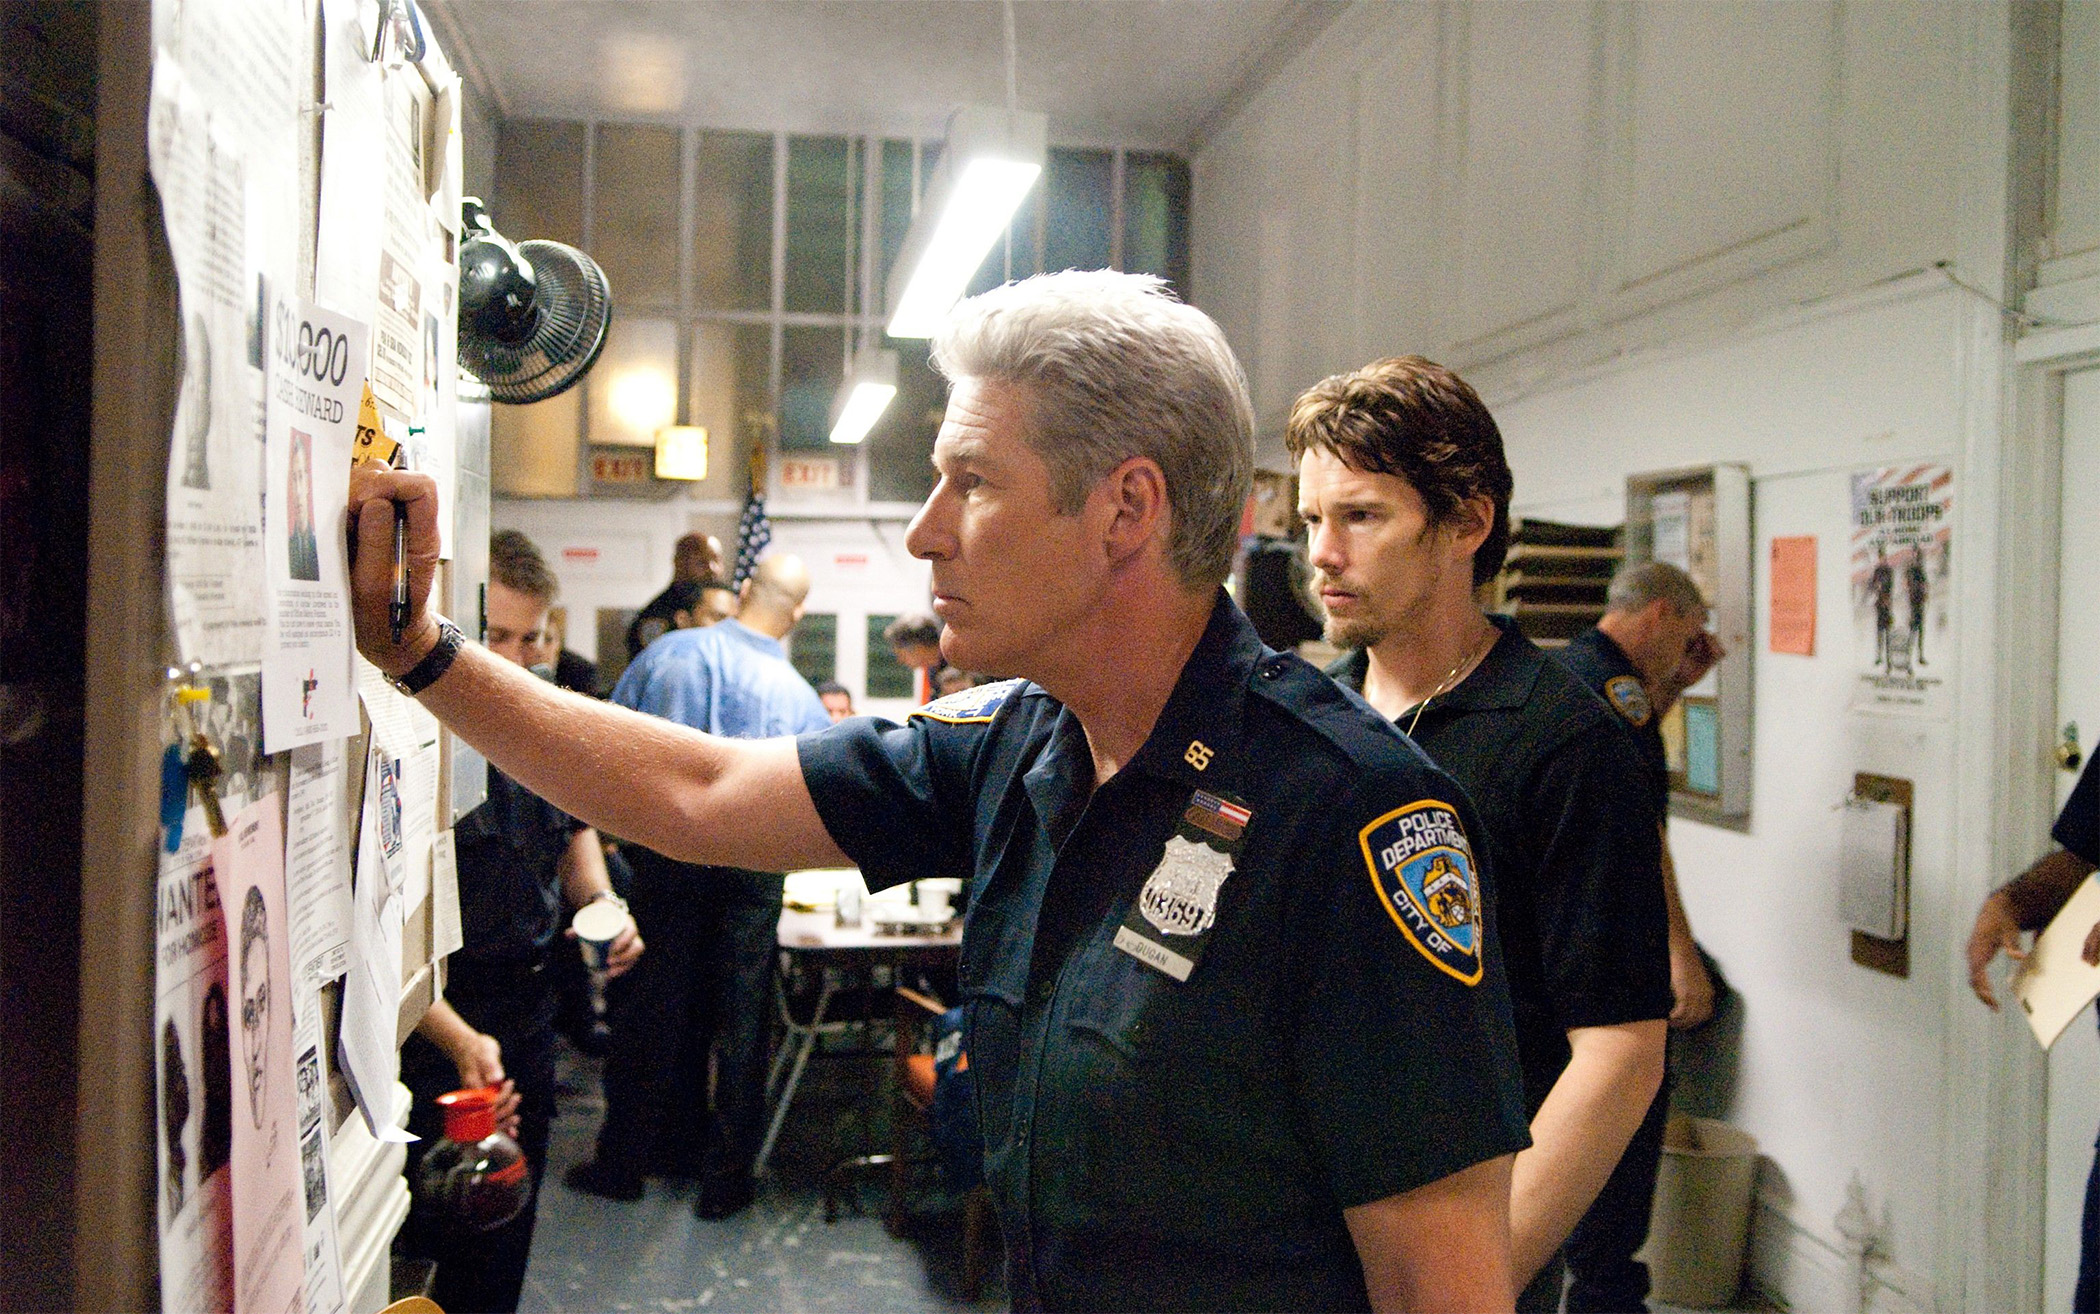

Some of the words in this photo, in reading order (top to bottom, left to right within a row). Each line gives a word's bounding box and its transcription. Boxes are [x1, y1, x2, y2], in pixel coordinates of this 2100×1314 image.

[294, 384, 344, 424] REWARD
[594, 457, 643, 481] EXIT
[783, 462, 831, 482] EXIT
[1869, 484, 1929, 505] SUPPORT
[1890, 502, 1943, 522] TROOPS
[1184, 740, 1215, 771] 65
[1398, 811, 1455, 837] POLICE
[1392, 889, 1429, 931] CITY
[1135, 941, 1169, 967] DUGAN
[1425, 931, 1453, 953] OF
